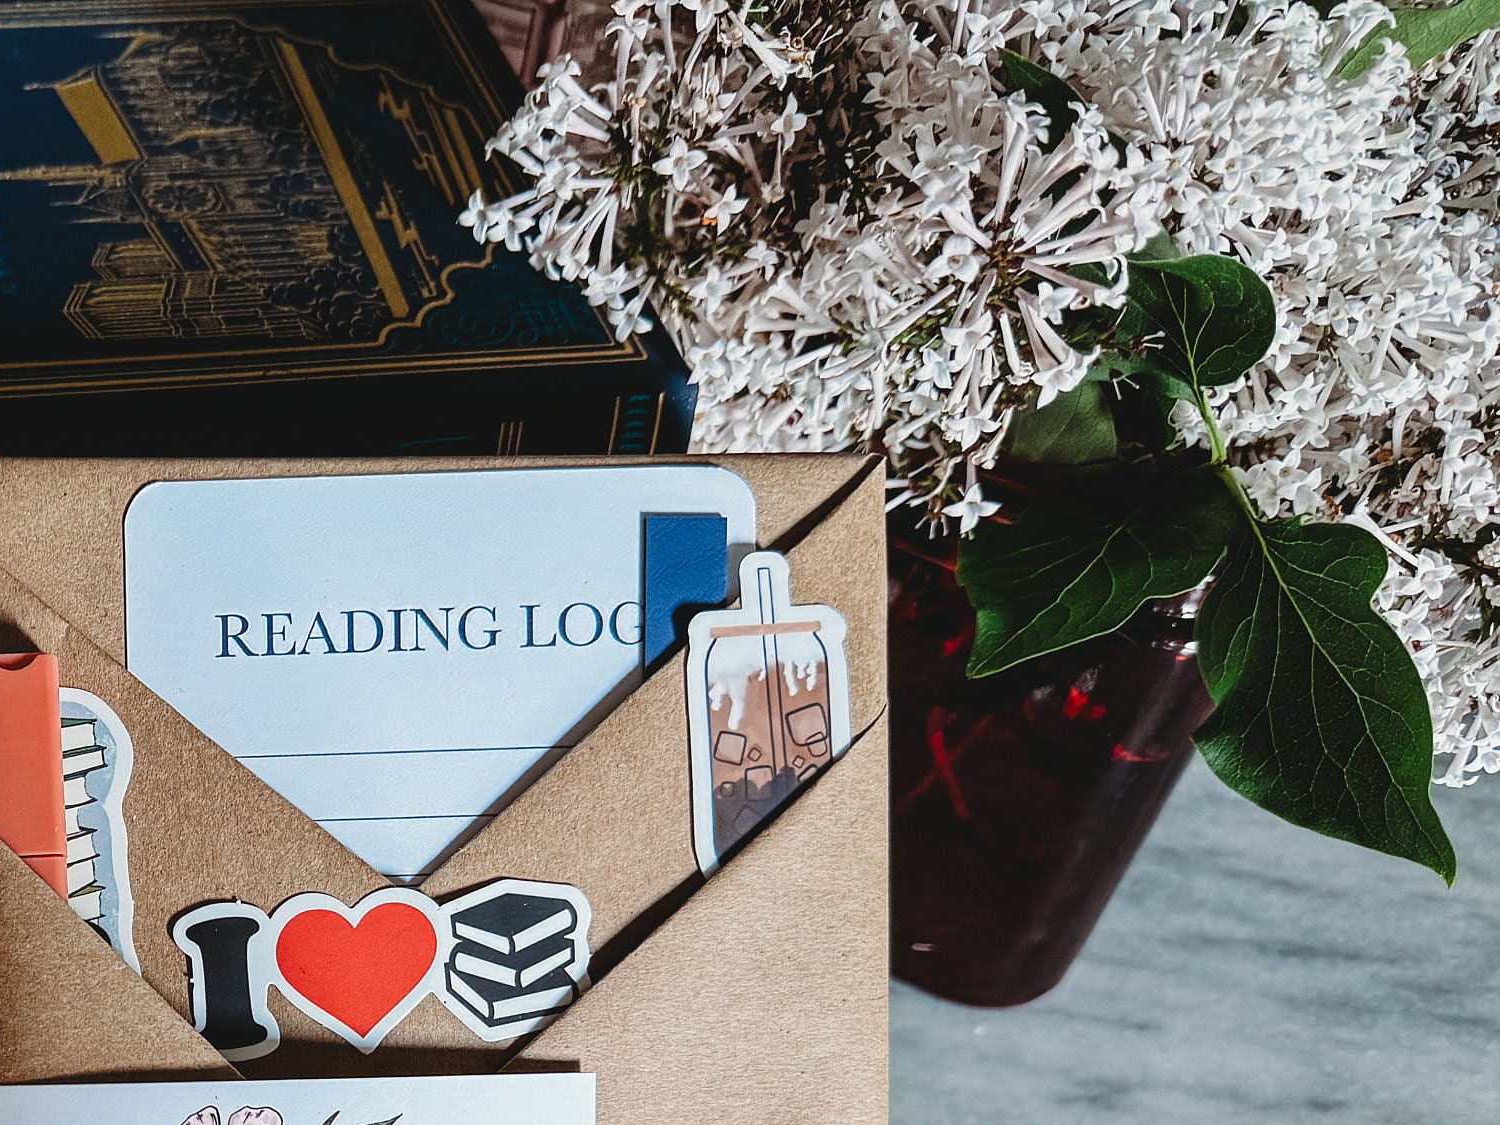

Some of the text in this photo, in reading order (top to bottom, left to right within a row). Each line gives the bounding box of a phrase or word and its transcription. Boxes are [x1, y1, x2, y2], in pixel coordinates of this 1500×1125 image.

[215, 601, 645, 659] READING LOG
[185, 916, 268, 1050] I
